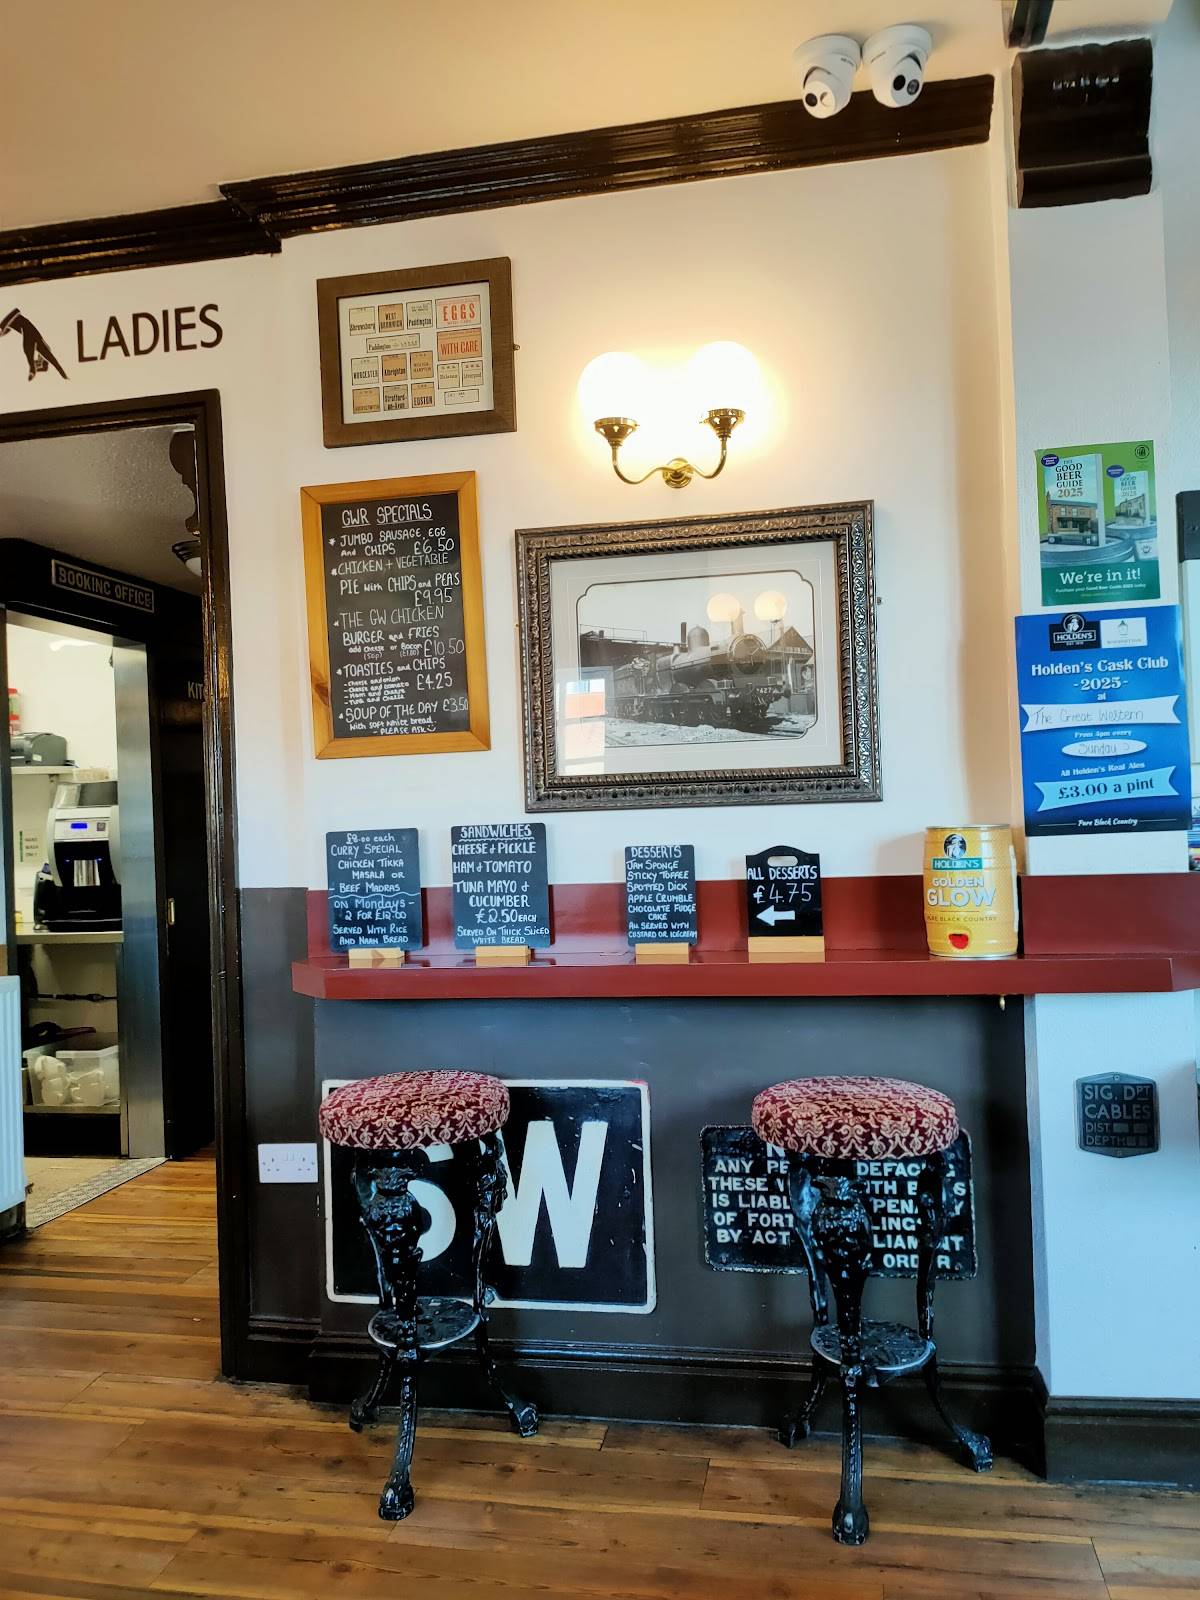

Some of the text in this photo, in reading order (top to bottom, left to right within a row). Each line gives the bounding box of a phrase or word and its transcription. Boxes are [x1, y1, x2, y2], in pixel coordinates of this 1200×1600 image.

[443, 303, 475, 321] EGGS
[77, 303, 223, 363] LADIES
[441, 340, 478, 355] WITH CARE
[1055, 463, 1082, 472] GOOD
[1056, 471, 1082, 481] BEER
[1056, 480, 1083, 489] GUIDE
[1058, 488, 1083, 498] 2025
[342, 504, 432, 526] GWR SPECIALS
[341, 527, 445, 546] JUMBO EGG
[365, 537, 454, 556] CHIPS £6.50
[338, 560, 382, 575] CHICKEN
[396, 552, 448, 568] VEGETABLE
[1060, 568, 1141, 584] We're in it!
[341, 580, 359, 595] PIE
[388, 575, 416, 592] CHIPS
[436, 572, 459, 586] PEAS
[115, 585, 151, 608] OFFICE
[415, 588, 452, 606] £9.95
[340, 606, 444, 629] THE GW CHICKEN
[343, 626, 439, 646] BURGER and FRIES
[1057, 633, 1093, 641] HOLDEN'S
[344, 662, 393, 678] TOASTIES
[413, 658, 445, 671] CHIPS
[1032, 656, 1168, 676] Holden's Cask Club
[417, 672, 452, 690] £4.25
[1097, 692, 1106, 700] at
[346, 697, 468, 723] SOUP OF THE DAY £3.50
[1034, 707, 1144, 724] The Great Western
[381, 727, 409, 735] PLEASE
[1073, 767, 1105, 775] Holden's
[1059, 778, 1154, 799] £3.00 a pint
[1094, 818, 1111, 826] Black
[1113, 818, 1138, 826] Country
[374, 833, 395, 842] each
[461, 824, 532, 838] SANDWICHES
[331, 844, 402, 858] CURRY SPECIAL
[452, 841, 536, 855] CHEESE PICKLE
[632, 846, 681, 858] DESSERTS
[338, 856, 404, 869] CHICKEN TIKKA
[453, 860, 531, 873] HAM TOMATO
[626, 859, 679, 871] JAM SPONGE
[934, 860, 979, 869] HOLDEN'S
[352, 871, 384, 879] MASALA
[627, 870, 689, 883] STICKY TOFFEE
[747, 865, 817, 880] ALL DESSERTS
[340, 882, 400, 893] BEEF MADRAS
[453, 880, 517, 893] TUNA MAYO
[627, 881, 687, 893] SPOTTED DICK
[932, 877, 984, 888] GOLDEN
[628, 893, 693, 903] APPLE CRUMBLE
[753, 883, 814, 904] £4.75
[927, 888, 996, 907] GLOW
[334, 895, 405, 912] ON Mondays
[469, 895, 530, 907] CUCUMBER
[345, 909, 406, 920] 2 FOR £12.00
[628, 904, 696, 914] CHOCOLATE FUDGE
[475, 909, 536, 923] £2.50 EACH
[333, 923, 407, 935] SERVED WITH RICE
[457, 926, 483, 936] SERVED
[486, 927, 496, 935] ON
[498, 925, 521, 935] THICK
[340, 935, 408, 945] AND NAAN BREAD
[1084, 1085, 1117, 1100] SIG.
[1085, 1104, 1151, 1119] CABLES
[1086, 1122, 1111, 1133] DIST
[1086, 1136, 1125, 1145] DEPTH
[714, 1160, 753, 1174] ANY
[709, 1176, 768, 1192] THESE
[713, 1194, 729, 1207] IS
[713, 1213, 735, 1226] OF
[717, 1230, 790, 1245] BY ACT
